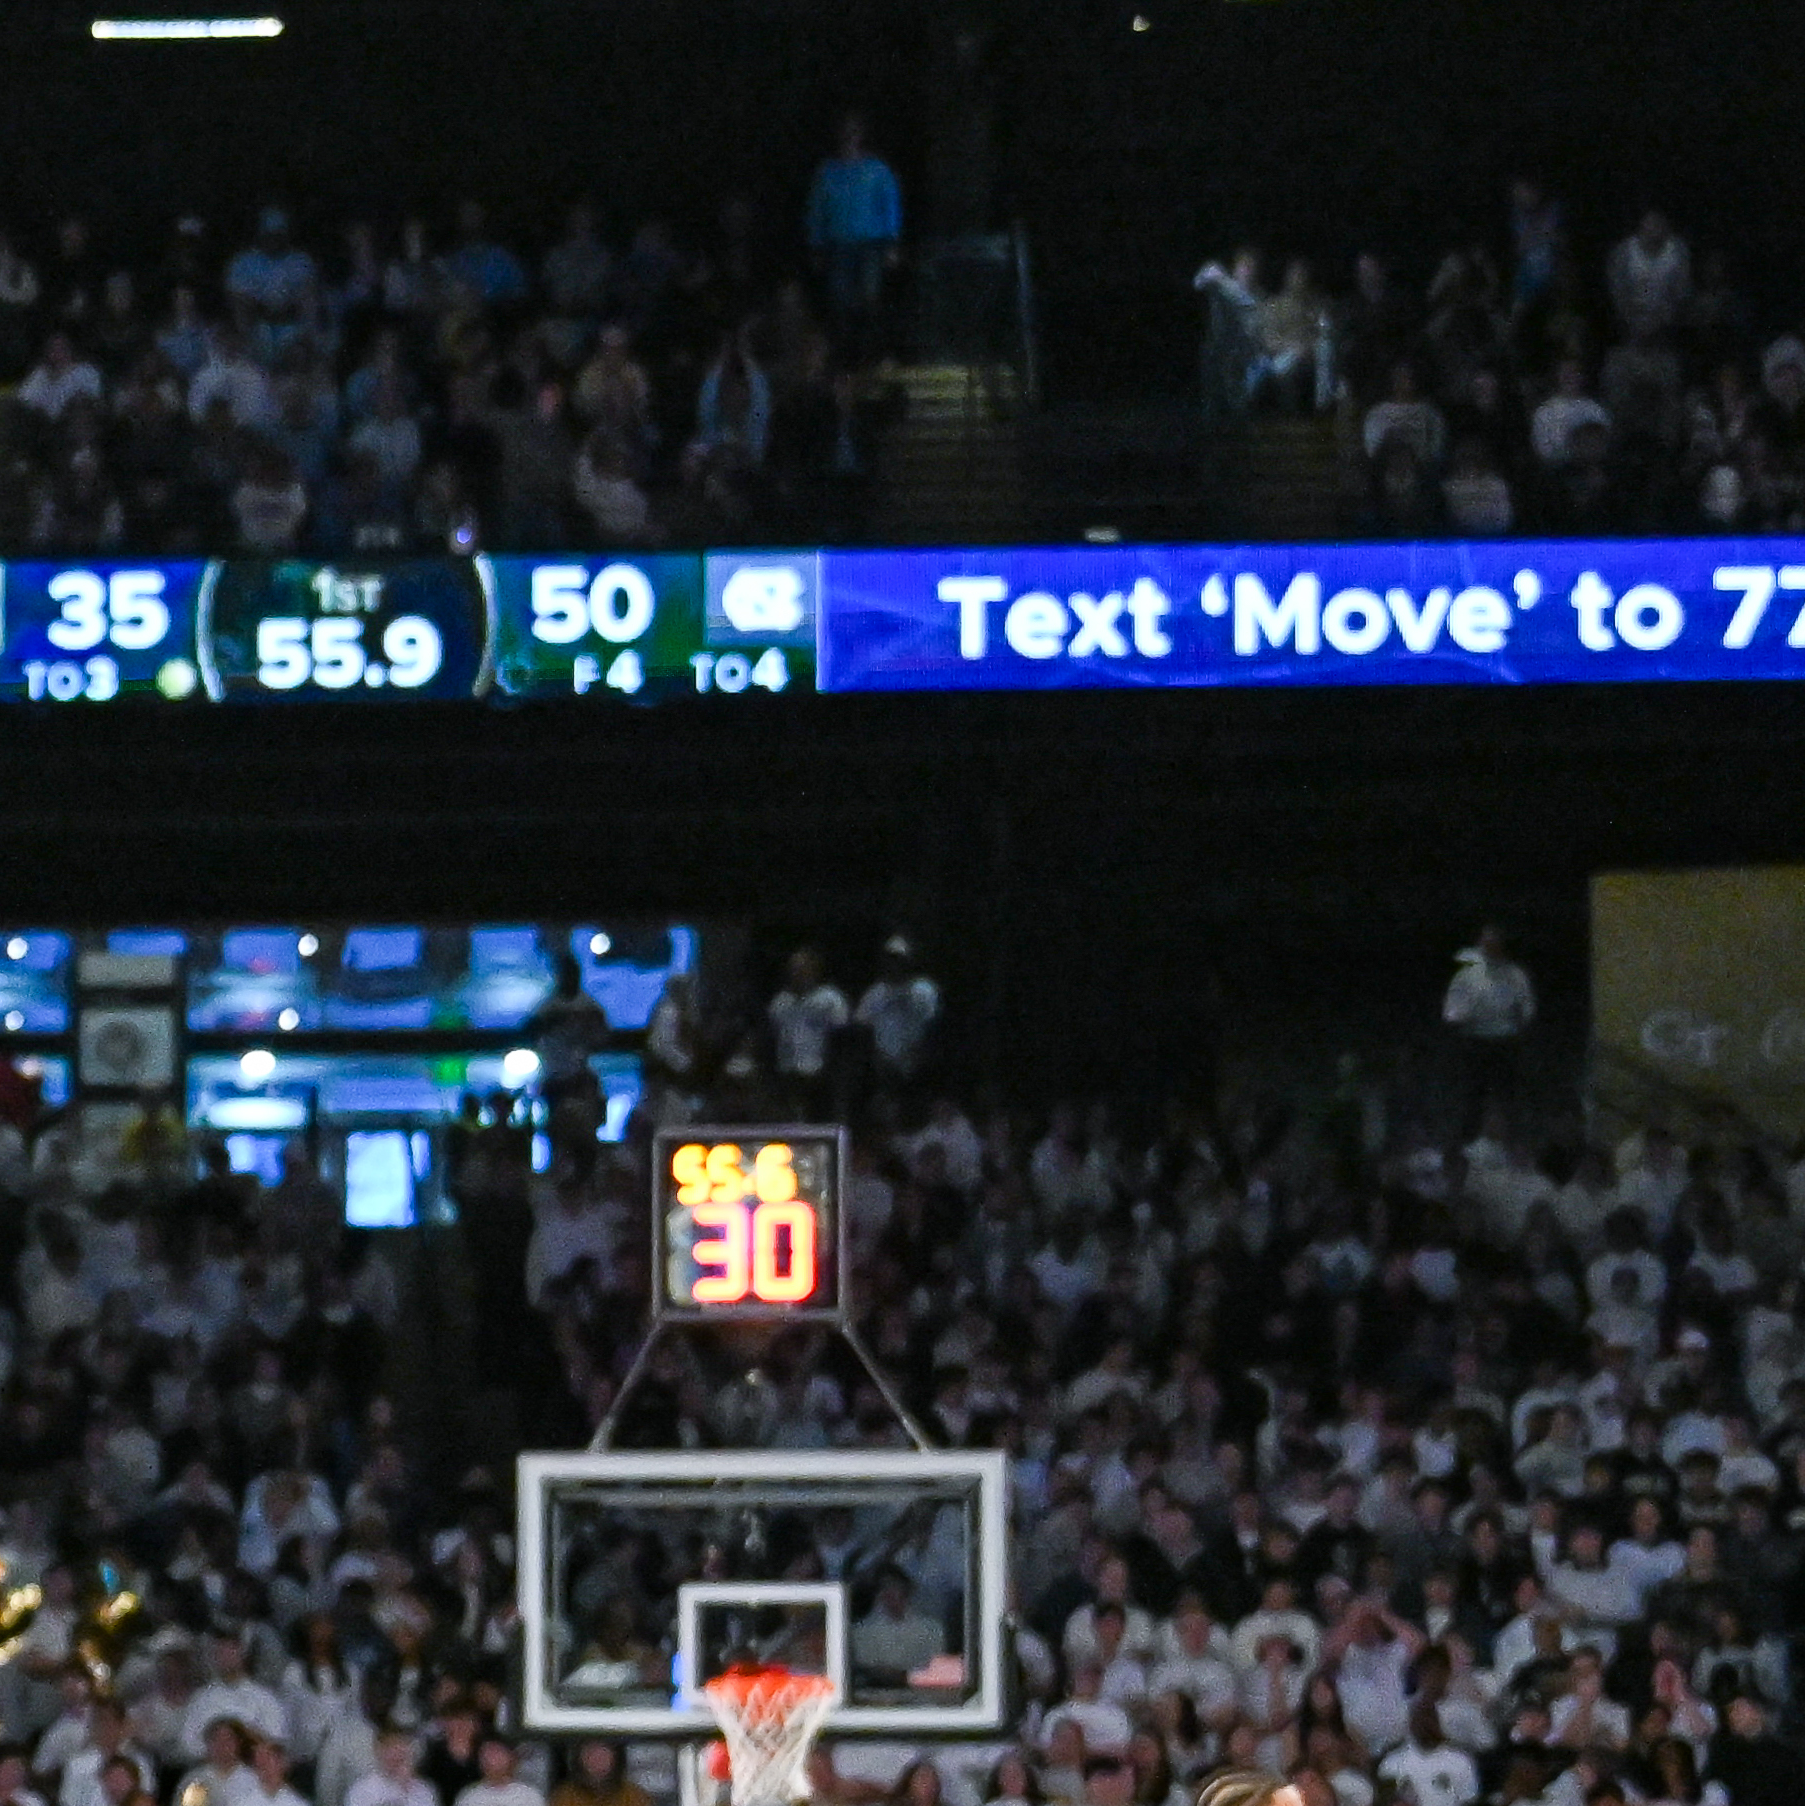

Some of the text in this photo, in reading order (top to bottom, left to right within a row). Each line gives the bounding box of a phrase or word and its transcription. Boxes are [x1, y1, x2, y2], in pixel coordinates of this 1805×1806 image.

[46, 568, 171, 650] 35
[531, 562, 656, 644] 50
[937, 574, 1173, 662] Text
[1569, 568, 1686, 651] to
[255, 614, 444, 690] 55.9
[605, 648, 646, 695] 4
[671, 1142, 799, 1205] 55.6
[691, 1200, 818, 1302] 30
